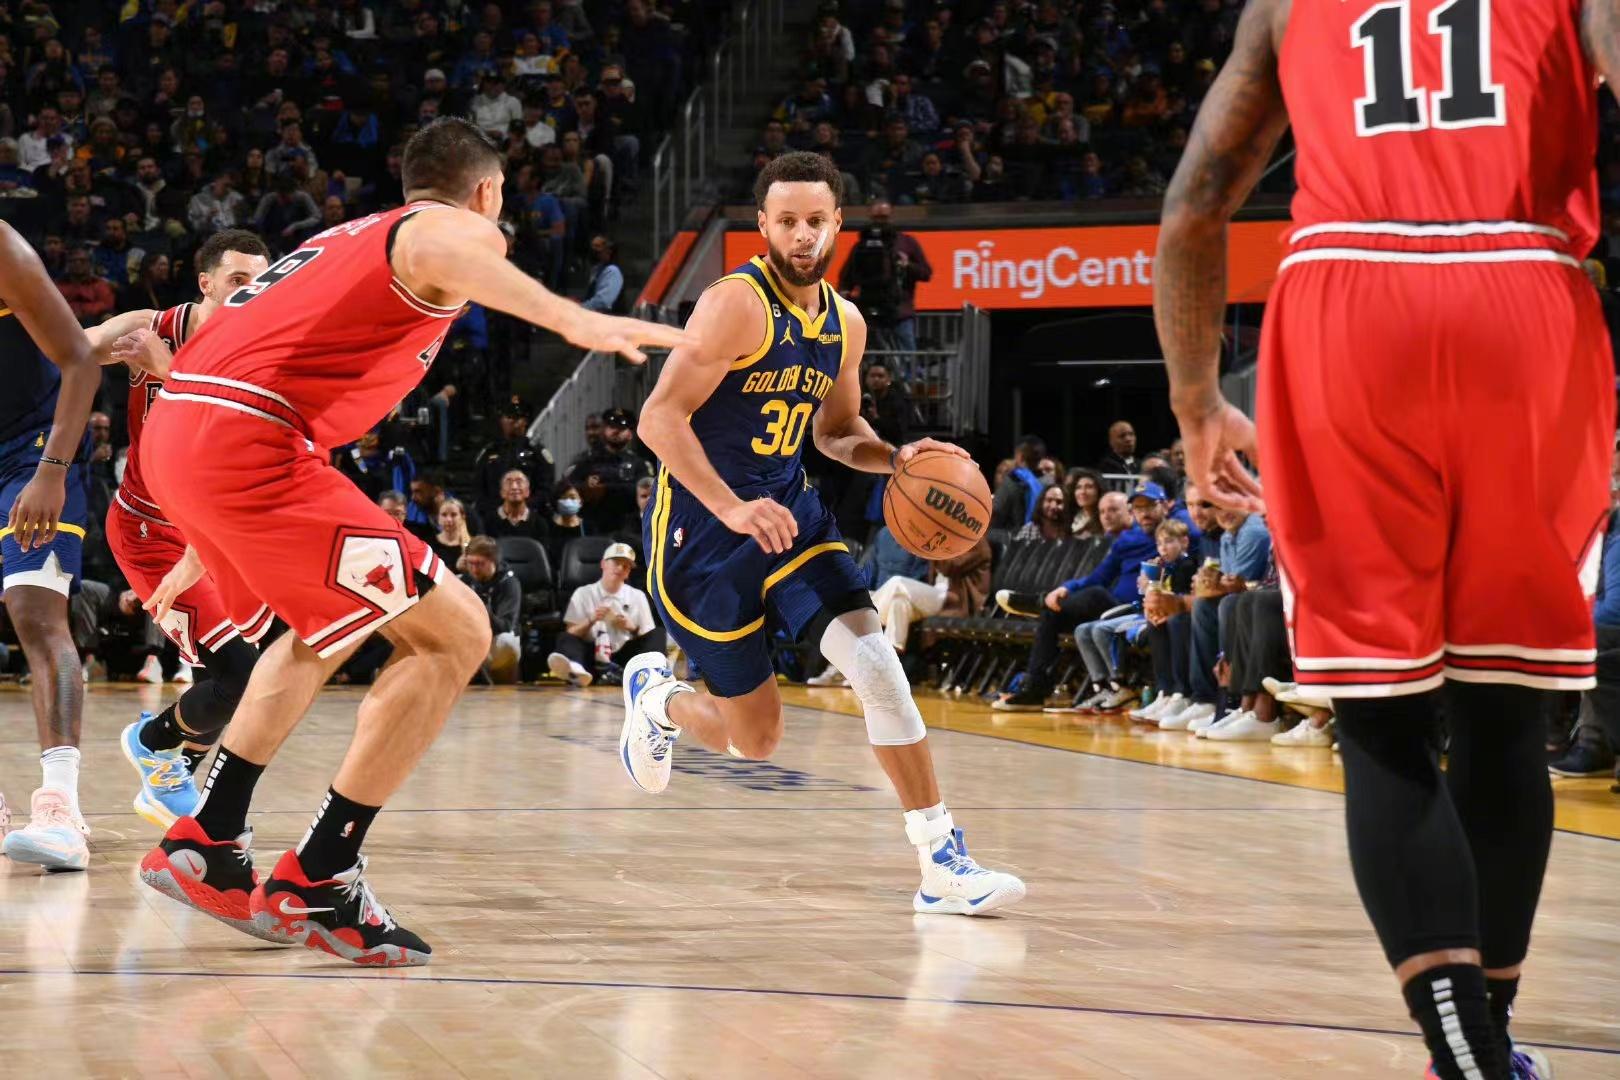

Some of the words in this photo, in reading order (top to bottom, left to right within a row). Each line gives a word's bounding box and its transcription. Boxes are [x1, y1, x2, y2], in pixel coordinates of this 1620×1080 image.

[1349, 0, 1507, 137] 11
[771, 303, 782, 318] 6
[741, 364, 802, 393] GOLDEN
[750, 399, 813, 456] 30
[925, 485, 983, 535] Wilson
